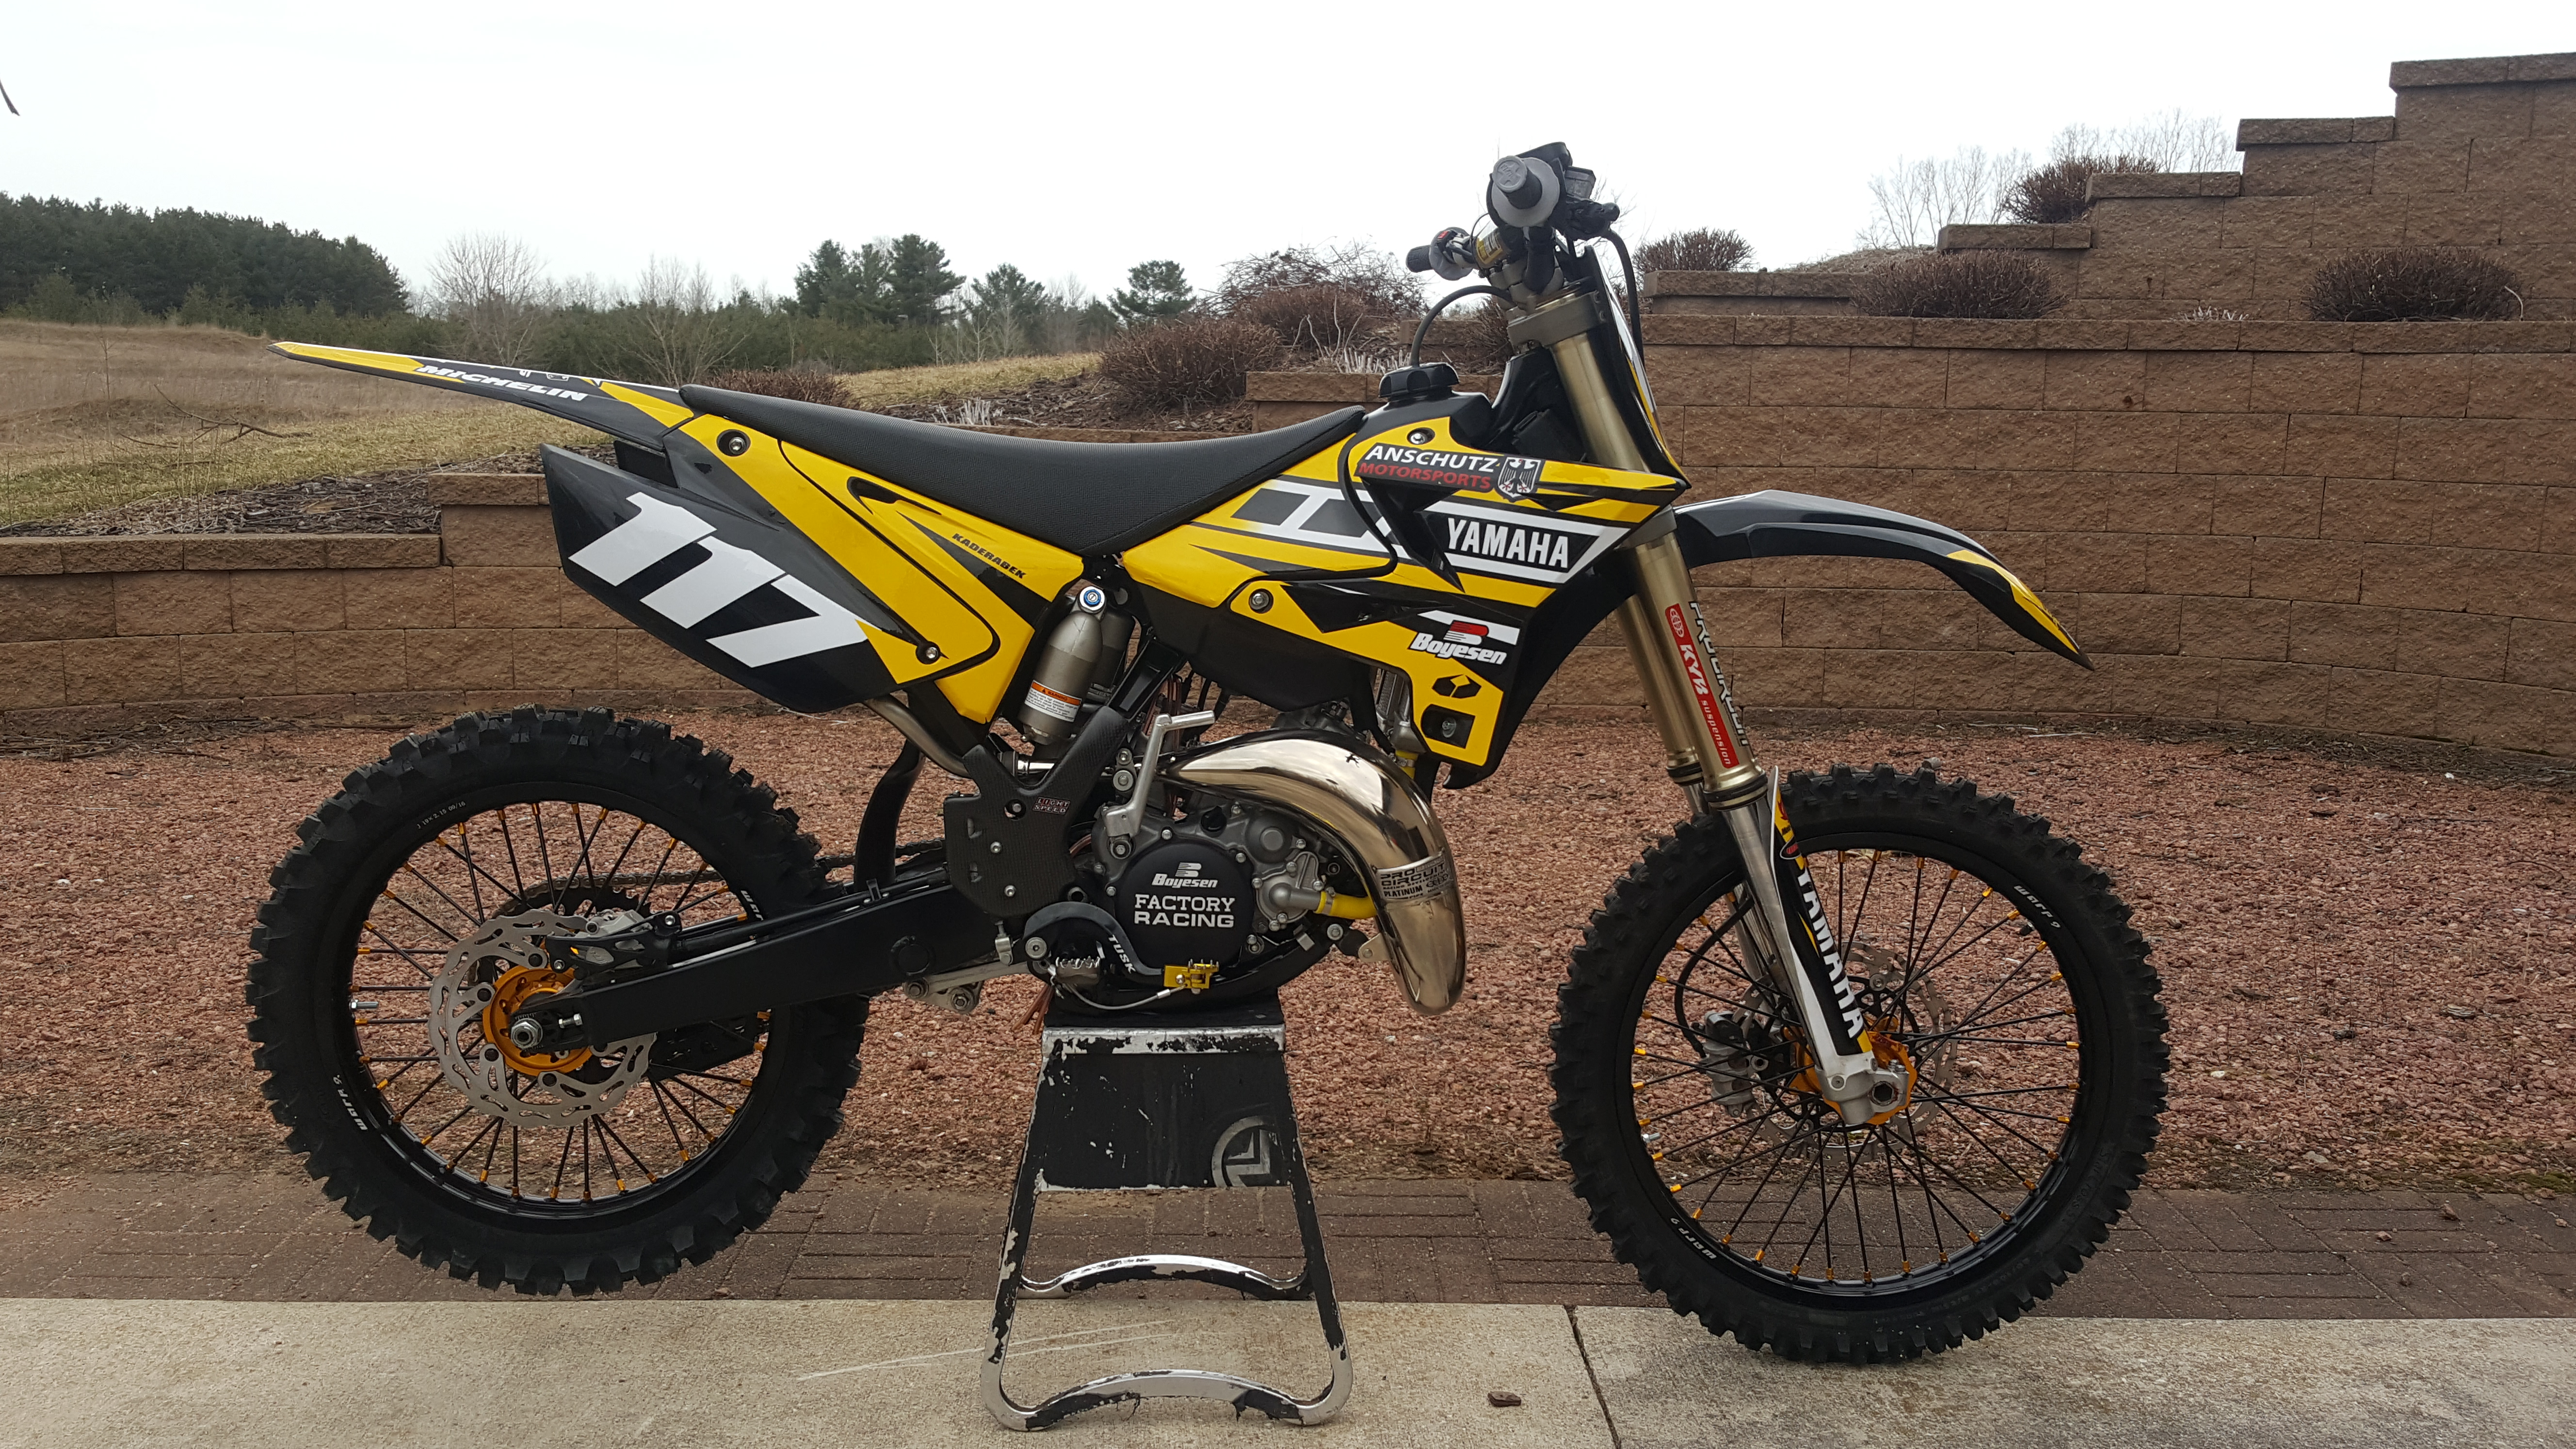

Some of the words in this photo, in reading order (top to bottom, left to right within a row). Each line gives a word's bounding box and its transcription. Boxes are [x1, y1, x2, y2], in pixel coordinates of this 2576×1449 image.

[416, 365, 588, 402] MICHELIN
[1365, 446, 1495, 473] ANSCHUTZ
[1358, 463, 1492, 489] MOTORSPORTS
[952, 533, 1027, 579] KADERABEK
[1447, 517, 1569, 569] YAMAHA
[568, 491, 873, 669] 117
[1410, 632, 1507, 665] Boyesen
[1680, 644, 1709, 695] KYB
[1701, 700, 1731, 765] suspension
[1034, 805, 1066, 813] SPEED
[1038, 798, 1069, 807] LIGHT
[1151, 873, 1218, 888] Boyesen
[1381, 868, 1415, 880] PRO
[1381, 863, 1445, 886] CIRCUIT
[1135, 894, 1235, 912] FACTORY
[1384, 885, 1423, 897] PLATINUM
[1134, 911, 1234, 928] RACING
[1108, 934, 1136, 974] TUSK
